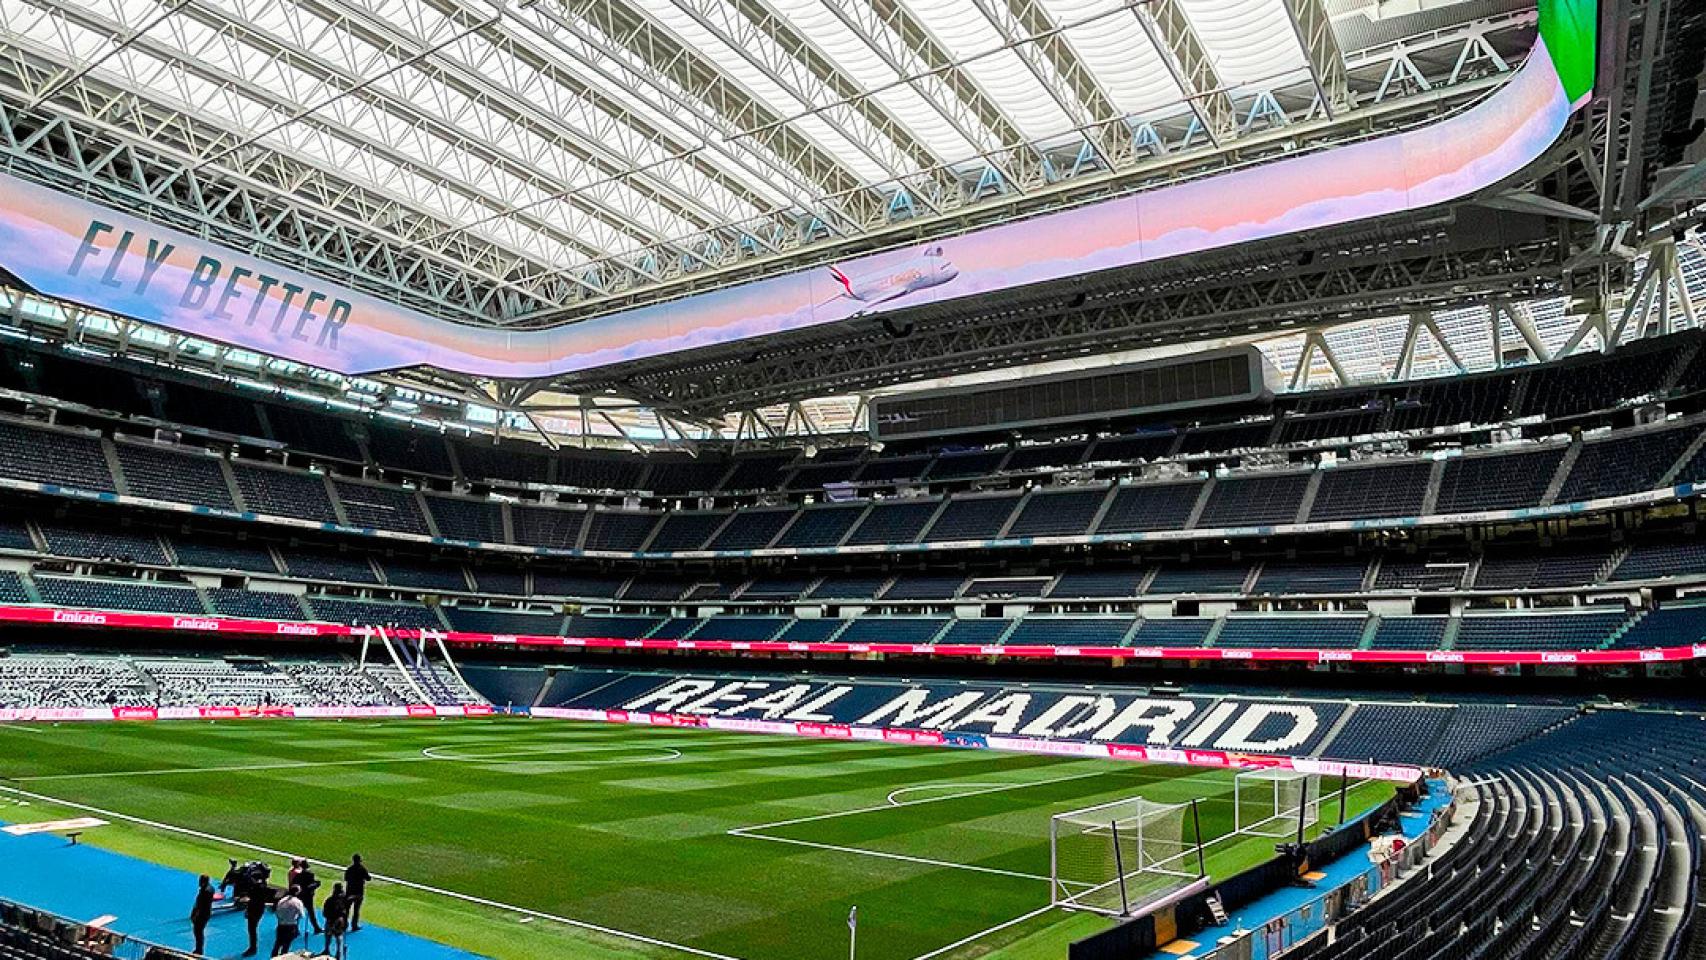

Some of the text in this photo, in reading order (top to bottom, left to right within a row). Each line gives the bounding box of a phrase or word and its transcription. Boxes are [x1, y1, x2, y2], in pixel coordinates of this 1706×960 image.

[68, 220, 353, 351] FLY BETTER
[53, 610, 107, 625] Emirates
[173, 616, 219, 630] Emirates
[277, 623, 319, 635] Emirates
[1427, 651, 1464, 662] Emirates
[621, 678, 1318, 753] REAL MADRID
[1113, 746, 1143, 757] Emirates
[1190, 752, 1224, 763] Emirates
